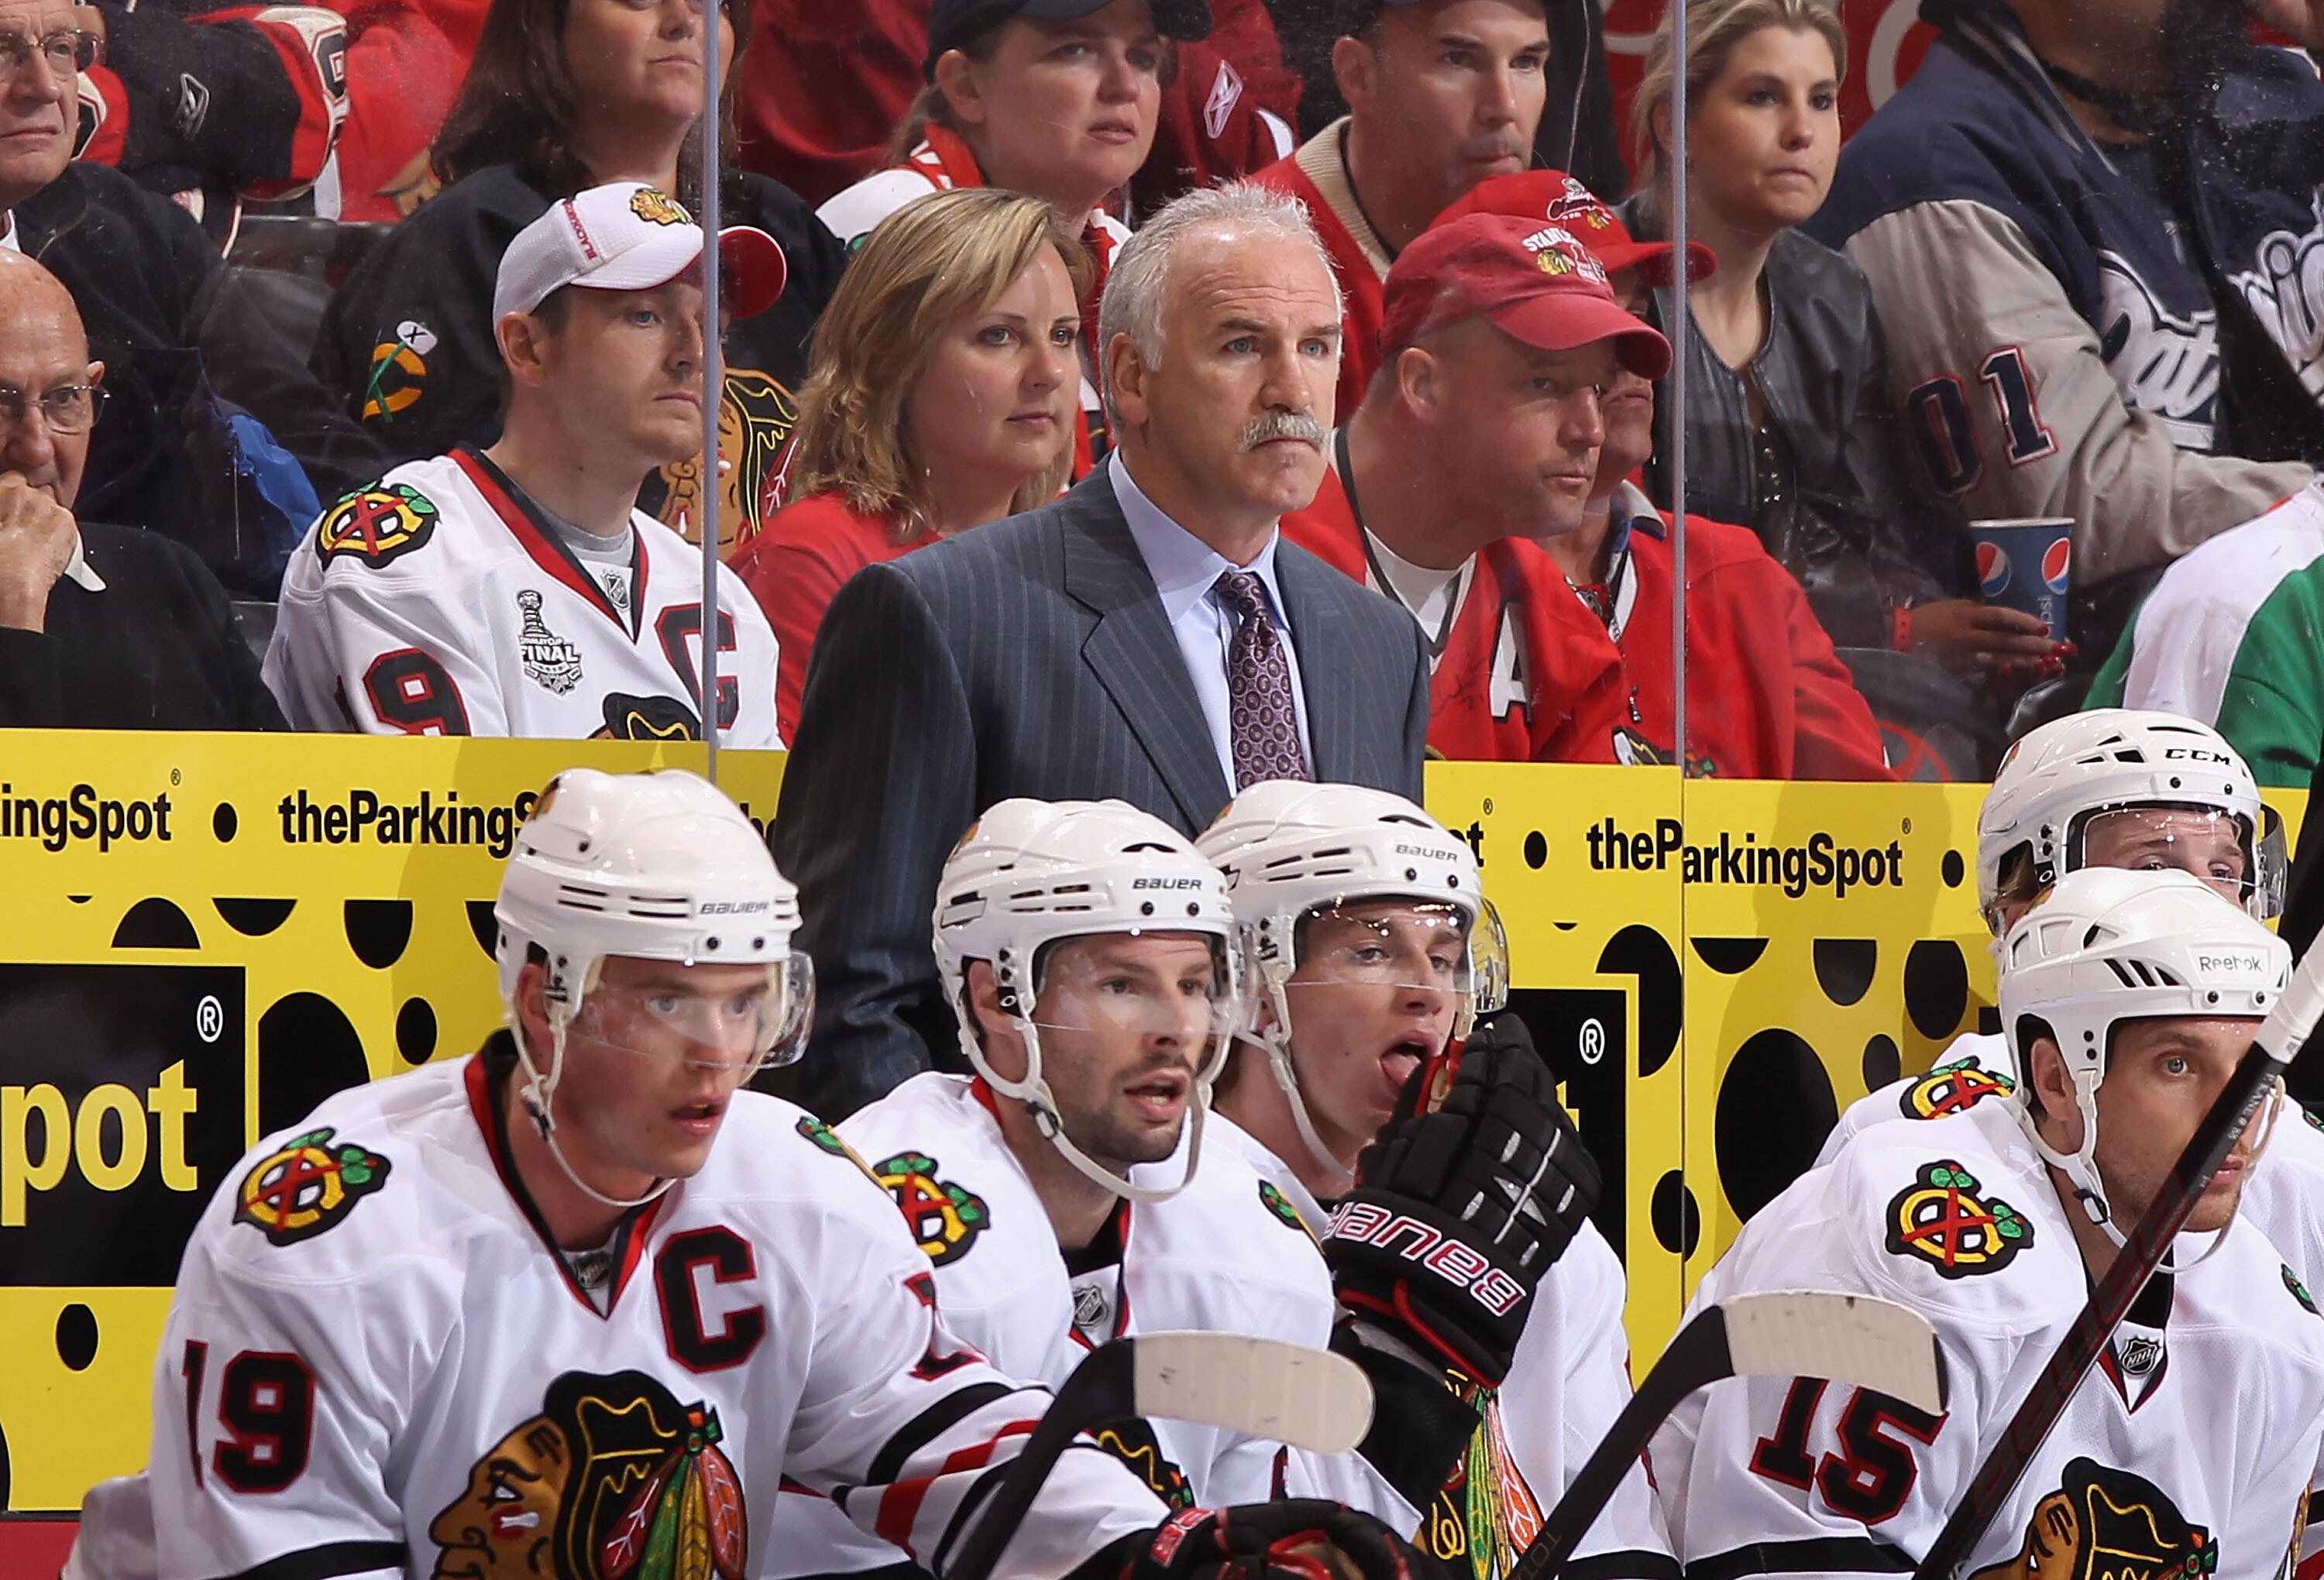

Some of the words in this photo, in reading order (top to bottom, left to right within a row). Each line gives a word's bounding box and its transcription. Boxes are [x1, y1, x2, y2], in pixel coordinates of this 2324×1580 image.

[1904, 346, 2059, 496] 01
[521, 645, 579, 662] FINAL
[1489, 601, 1532, 723] A
[2164, 748, 2231, 765] CCM
[0, 783, 171, 853] ingSpot
[1587, 818, 1903, 898] theParkingSpot
[654, 1224, 766, 1374] C
[181, 1339, 316, 1495] 19
[1748, 1376, 1949, 1525] 15
